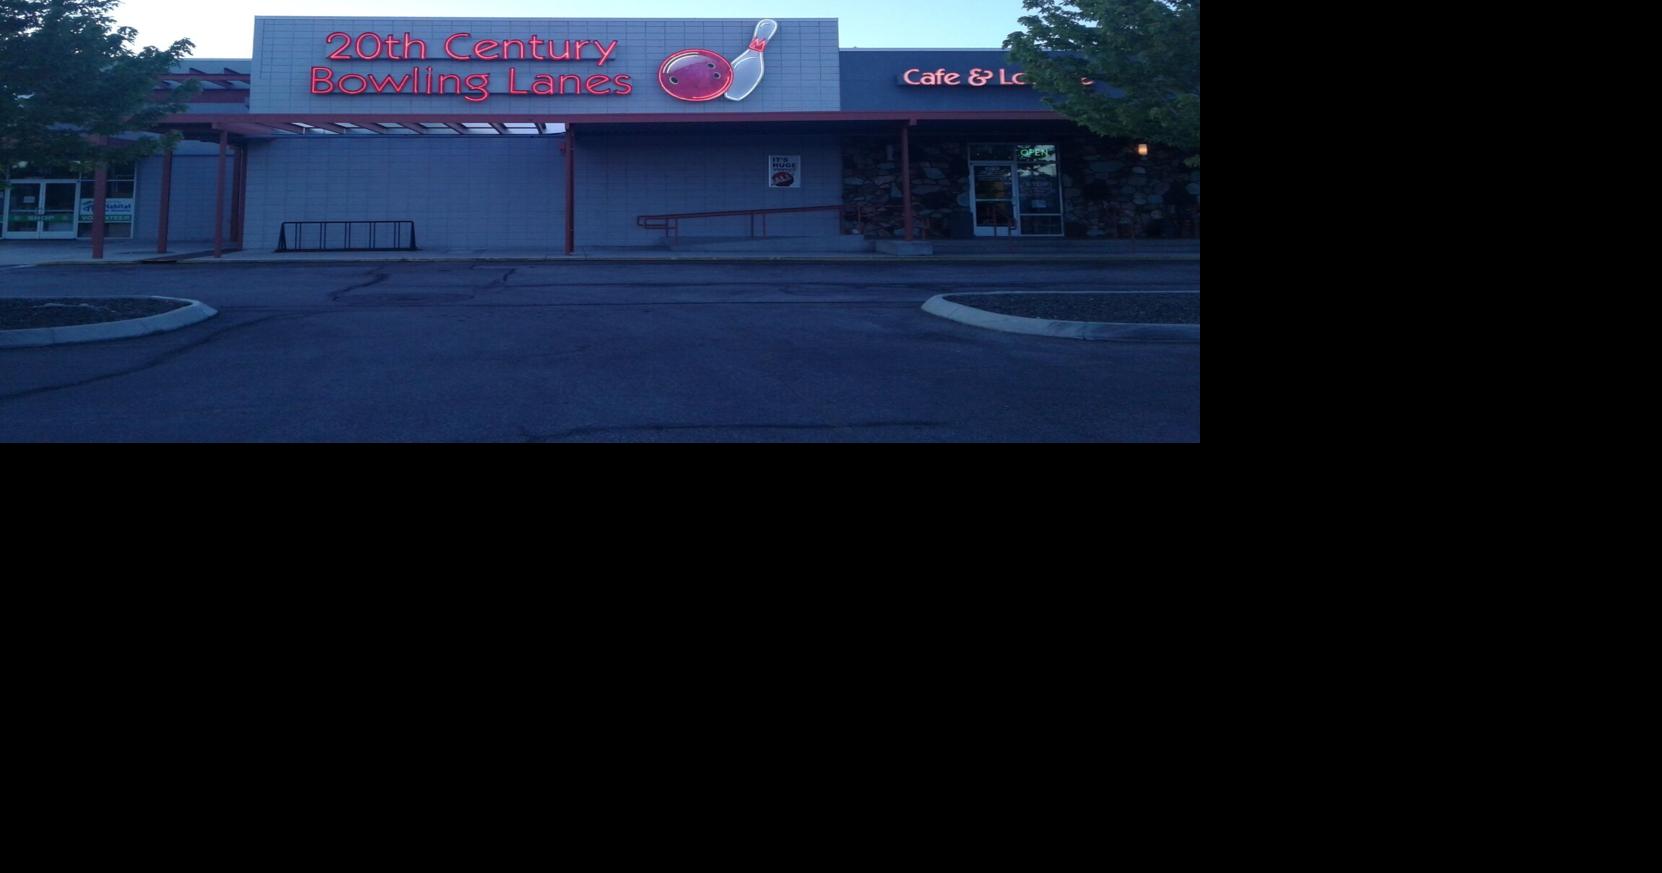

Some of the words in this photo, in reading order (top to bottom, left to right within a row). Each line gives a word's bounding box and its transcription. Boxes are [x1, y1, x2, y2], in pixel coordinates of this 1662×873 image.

[325, 31, 427, 61] 20th
[444, 31, 618, 67] Century
[310, 66, 492, 103] Bowling
[508, 67, 633, 96] Lanes
[903, 68, 962, 86] Cafe
[968, 68, 993, 86] &
[1020, 148, 1049, 158] OPEN
